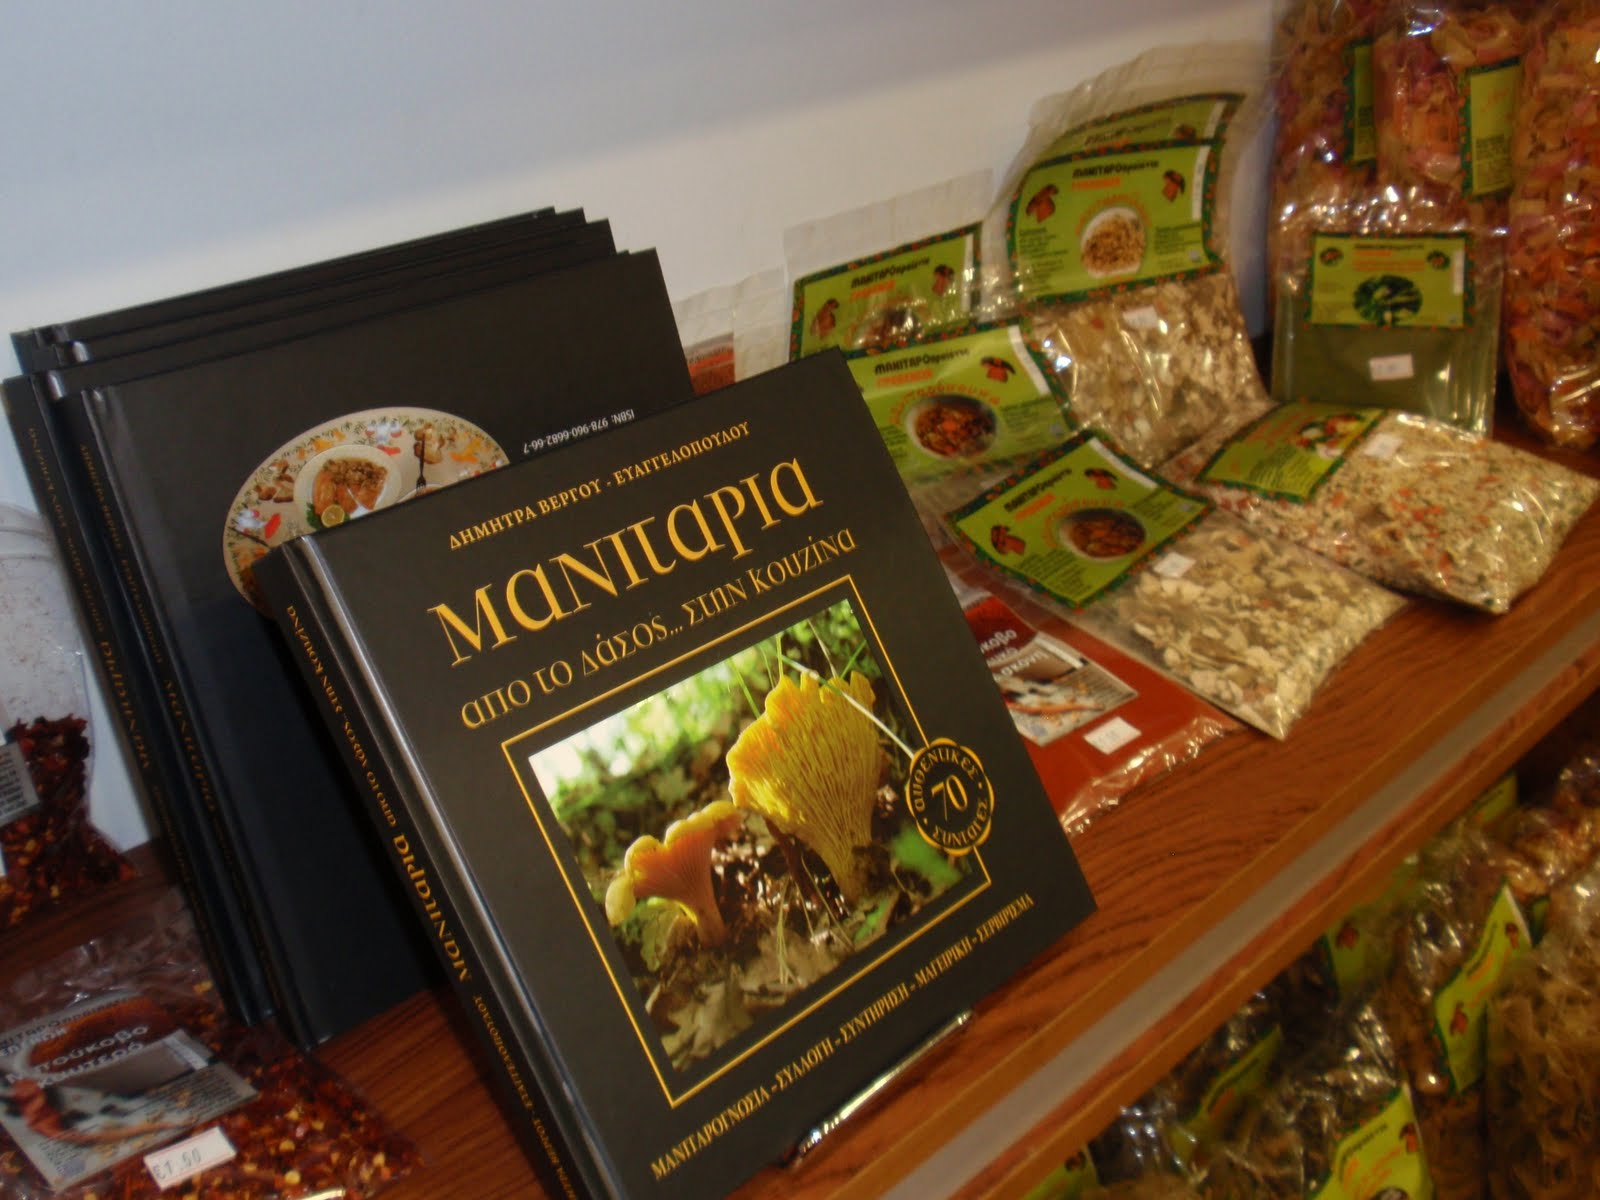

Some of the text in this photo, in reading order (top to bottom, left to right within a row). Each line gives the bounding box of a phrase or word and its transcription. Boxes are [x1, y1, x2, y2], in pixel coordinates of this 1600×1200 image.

[523, 408, 635, 454] ISBN: 978-960-6682-66-7
[449, 421, 751, 551] ΔΗΜΗΤΡΑ ΒΕΡΓΟΥ ΕΥΑΓΓΕΛΟΠΟΥΛΟΥ
[931, 774, 968, 821] 70
[650, 892, 1035, 1181] ΜΑΝΙΤΑΡΟΓΝΩΣΙΑ ΣΥΛΛΟΓΗ ΣΥΝΤΗΡΗΣΗ ΜΑΓΕΙΡΙΚΗ ΣΕΡΒΙΡΙΣΜΑ
